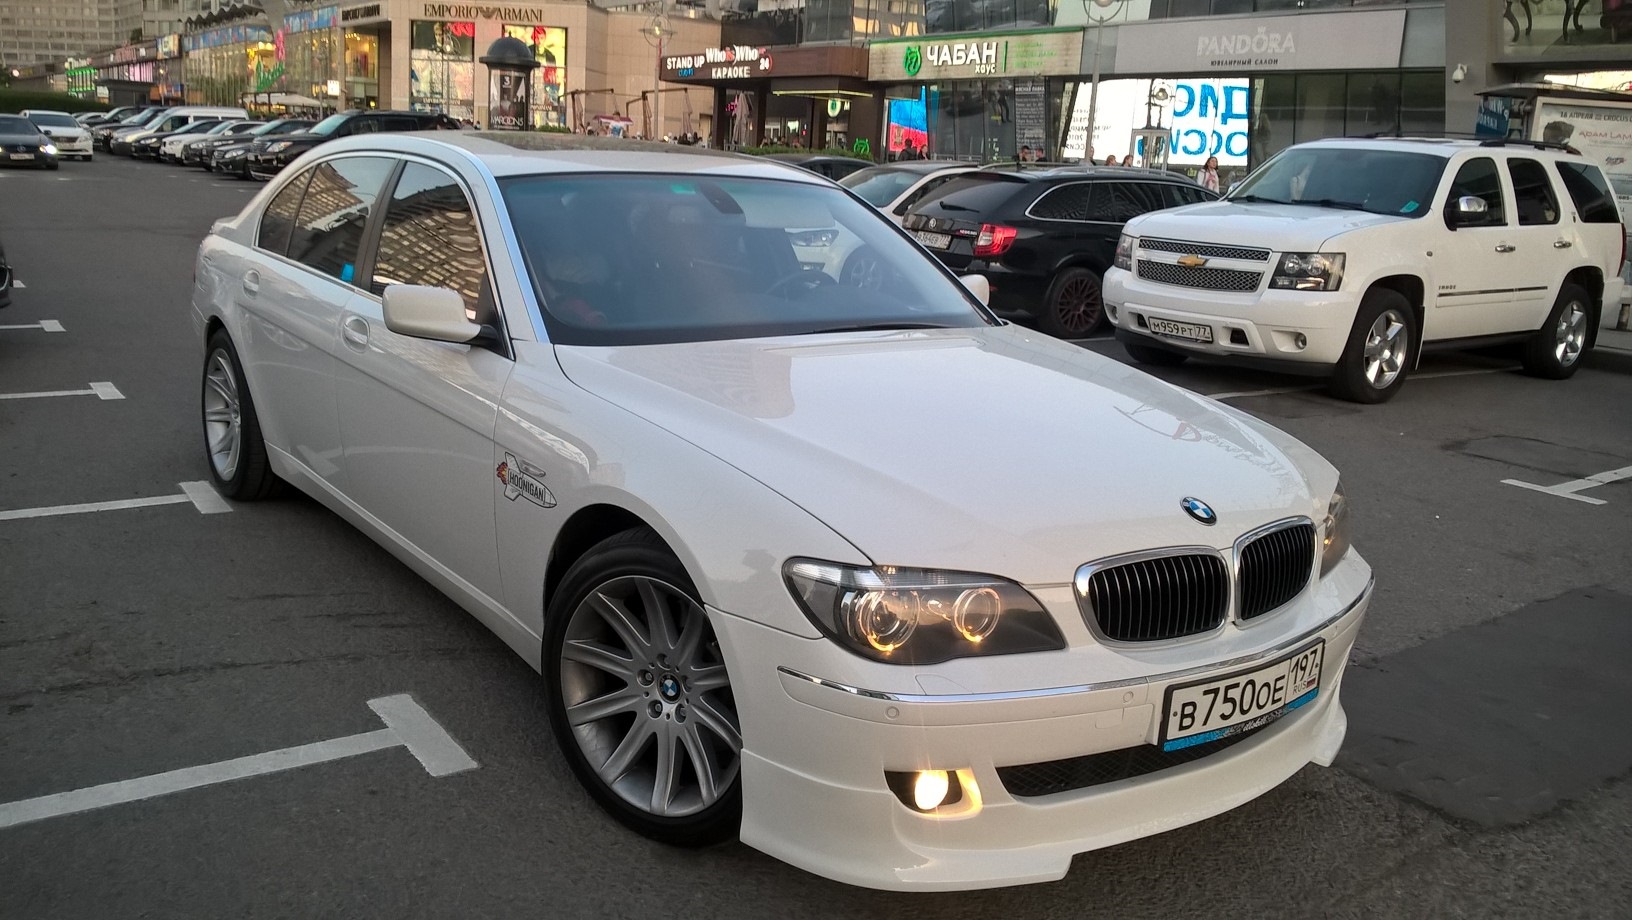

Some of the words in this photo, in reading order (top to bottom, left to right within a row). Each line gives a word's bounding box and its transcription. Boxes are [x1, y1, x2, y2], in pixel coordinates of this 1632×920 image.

[424, 4, 478, 18] EMPORIO
[495, 8, 543, 22] ARMANI
[1197, 27, 1296, 56] PANDORA
[666, 56, 693, 69] STAND
[694, 54, 706, 68] UP
[927, 42, 998, 66] ЧАБАН
[759, 57, 770, 70] 24
[1195, 326, 1207, 335] 77
[509, 471, 544, 501] HOONIGAN
[1178, 674, 1286, 732] В750ОЕ
[1290, 648, 1318, 685] 197
[1292, 680, 1308, 695] RUS
